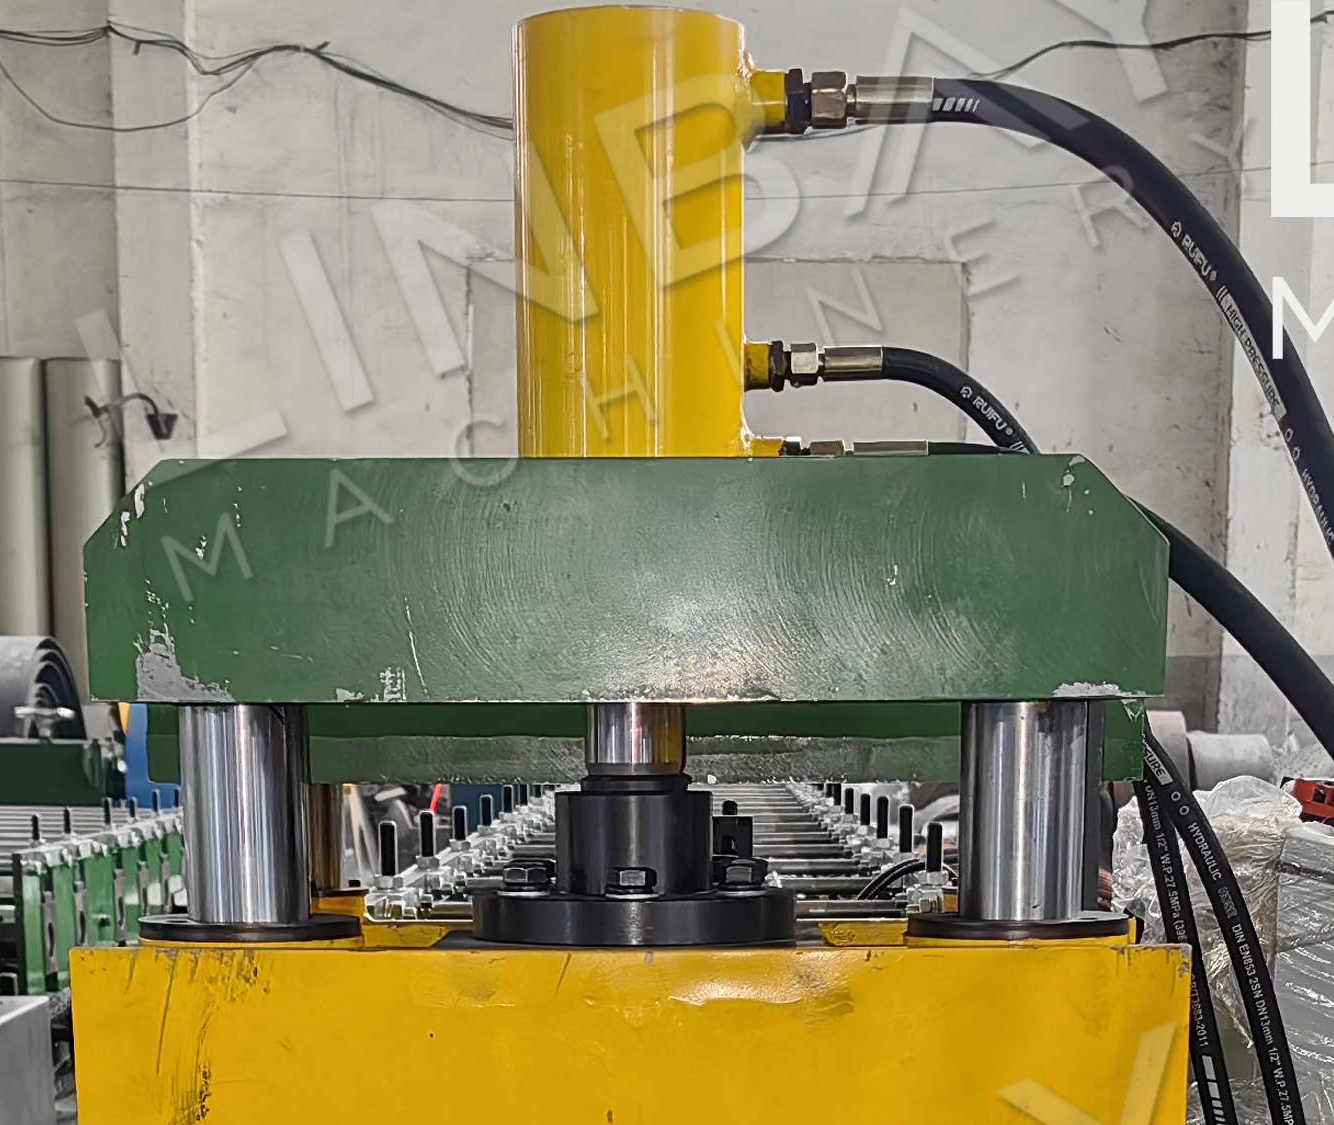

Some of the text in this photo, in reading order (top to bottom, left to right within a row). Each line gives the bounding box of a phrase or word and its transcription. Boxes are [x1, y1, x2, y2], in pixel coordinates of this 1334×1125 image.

[1188, 821, 1222, 881] HYDRAULIC
[1231, 924, 1246, 943] DIN
[1239, 943, 1256, 978] EN853
[1247, 975, 1264, 1003] 2SN
[1255, 1001, 1275, 1045] DN13mm
